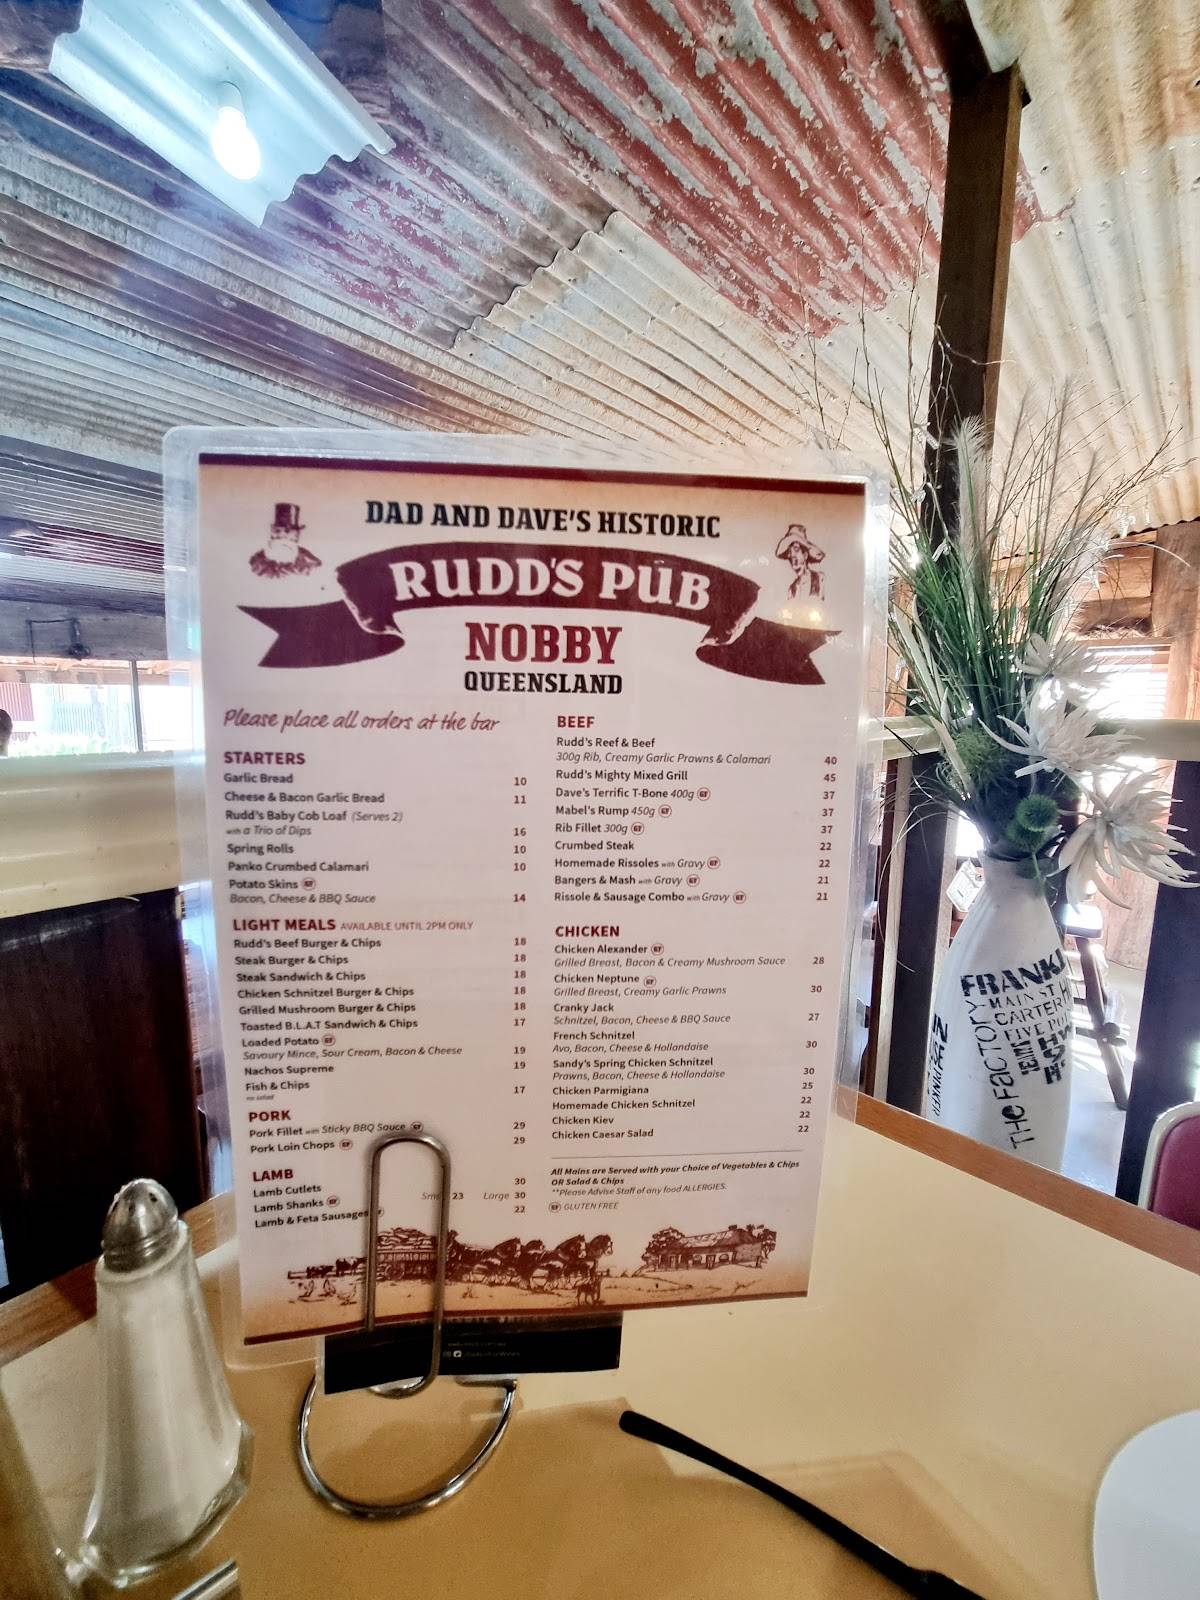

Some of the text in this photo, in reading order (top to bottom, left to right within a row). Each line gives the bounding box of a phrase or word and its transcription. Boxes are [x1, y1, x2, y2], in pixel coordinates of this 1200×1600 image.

[366, 501, 721, 538] DAD AND DAVE'S HISTORIC
[390, 557, 710, 610] RUDD'S PUB
[465, 622, 622, 664] NOBBY
[465, 671, 622, 695] QUEENSLAND
[223, 708, 501, 732] Please place all orders at the bar
[557, 716, 595, 728] BEEF
[556, 737, 655, 748] Rudd's Reef Beef
[224, 752, 305, 764] STARTERS
[224, 773, 527, 786] Garlic Bread 10
[556, 770, 836, 782] Rudd's Mighty Mixed Grill 45
[224, 792, 527, 804] Cheese Bacon Garlic Bread 11
[556, 788, 835, 801] Dave's Terrific T-Bone 400g 37
[225, 810, 347, 824] Rudd's Baby Cob Loaf
[556, 806, 834, 818] Mabel's Rump 450g 37
[556, 823, 832, 836] Rib Fillet 300g 37
[227, 843, 526, 856] Spring Rolls 10
[556, 840, 832, 851] Crumbed Steak 22
[228, 861, 526, 872] Panko Crumbed Calamari 10
[555, 858, 830, 870] Homemade Rissoles Gravy 22
[229, 879, 298, 890] Potato Skins
[554, 892, 828, 904] Rissole Sausage Combo Gravy 21
[233, 919, 474, 932] LIGHT MEALS AVAILABLE UNTIL 2PM ONLY
[556, 926, 620, 938] CHICKEN
[234, 937, 526, 951] Rudd's Beef Burger Chips 18
[554, 944, 648, 954] Chicken Alexander
[235, 953, 526, 967] Steak Burger Chips 18
[554, 974, 640, 986] Chicken Neptune
[238, 986, 526, 1000] Chicken Schnitzel Burger Chips 18
[239, 1002, 526, 1015] Grilled Mushroom Burger Chips 18
[554, 1002, 614, 1014] Cranky Jack
[240, 1018, 526, 1032] Toasted B.L.A.T Sandwich Chips 17
[242, 1036, 319, 1047] Loaded Potato
[244, 1061, 526, 1076] Nachos Supreme 19
[554, 1057, 713, 1070] Sandy's Spring Chicken Schnitzel
[246, 1080, 526, 1095] Fish Chips 17
[552, 1082, 813, 1097] Chicken Parmigiana 25
[249, 1110, 291, 1122] PORK
[552, 1110, 810, 1126] Chicken Kiev 22
[251, 1136, 525, 1154] Pork Loin Chops 29
[550, 1160, 800, 1176] All Mains are Served with your Choice of Vegetables Chips
[253, 1168, 293, 1182] LAMB
[254, 1177, 526, 1198] Lamb Cutlets 30
[254, 1191, 526, 1213] Lamb Shanks 23 Large 30
